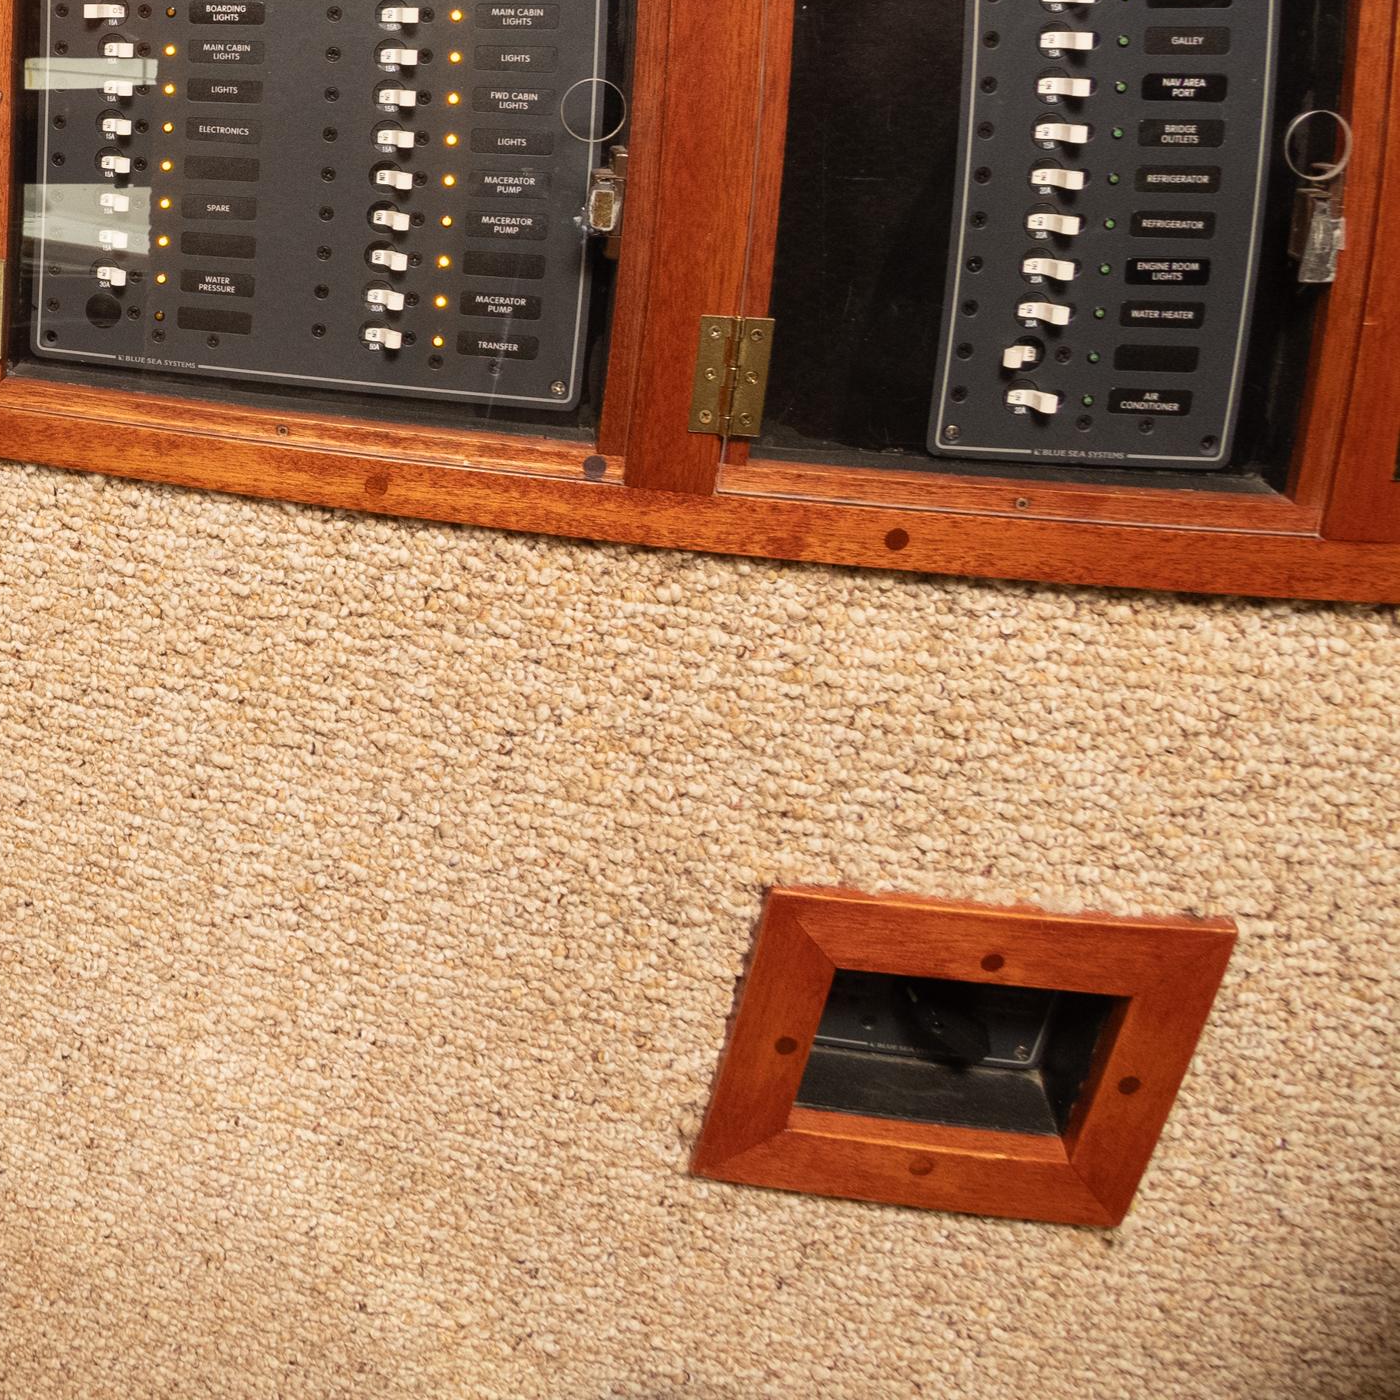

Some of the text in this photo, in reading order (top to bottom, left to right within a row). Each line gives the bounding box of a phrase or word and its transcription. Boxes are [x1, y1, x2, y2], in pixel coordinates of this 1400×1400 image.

[206, 4, 246, 12] BOARDING
[491, 8, 544, 16] MAIN CABIN
[212, 14, 240, 22] LIGHTS
[502, 18, 532, 26] LIGHTS
[1171, 36, 1204, 45] GALLEY
[203, 44, 250, 52] MAIN CABIN
[213, 52, 240, 60] LIGHTS
[501, 54, 530, 62] LIGHTS
[1162, 78, 1182, 86] NAV
[211, 86, 238, 94] LIGHTS
[1172, 88, 1196, 96] PORT
[490, 92, 538, 100] FWD CABIN
[499, 102, 528, 110] LIGHTS
[199, 126, 249, 136] ELECTRONICS
[1164, 124, 1196, 133] BRIDGE
[498, 138, 527, 146] LIGHTS
[1161, 135, 1198, 144] OUTLETS
[484, 176, 536, 186] MACERATOR
[1147, 174, 1209, 184] REFRIGERATOR
[496, 186, 522, 194] PUMP
[206, 204, 230, 212] SPARE
[482, 216, 532, 226] MACERATOR
[1142, 219, 1204, 230] REFRIGERATOR
[494, 226, 519, 234] PUMP
[1137, 262, 1200, 271] ENGINE ROOM
[205, 276, 230, 284] WATER
[1152, 272, 1184, 280] LIGHTS
[198, 284, 236, 294] PRESSURE
[476, 296, 526, 306] MACERATOR
[488, 305, 513, 314] PUMP
[1132, 310, 1194, 320] WATER HEATER
[478, 342, 518, 352] TRANSFER
[126, 356, 196, 368] BLUE SEA SYSTEMS
[1144, 392, 1160, 400] AIR
[1120, 400, 1180, 412] CONDITIONER
[1042, 449, 1124, 460] BLUE SEA SYSTEMS
